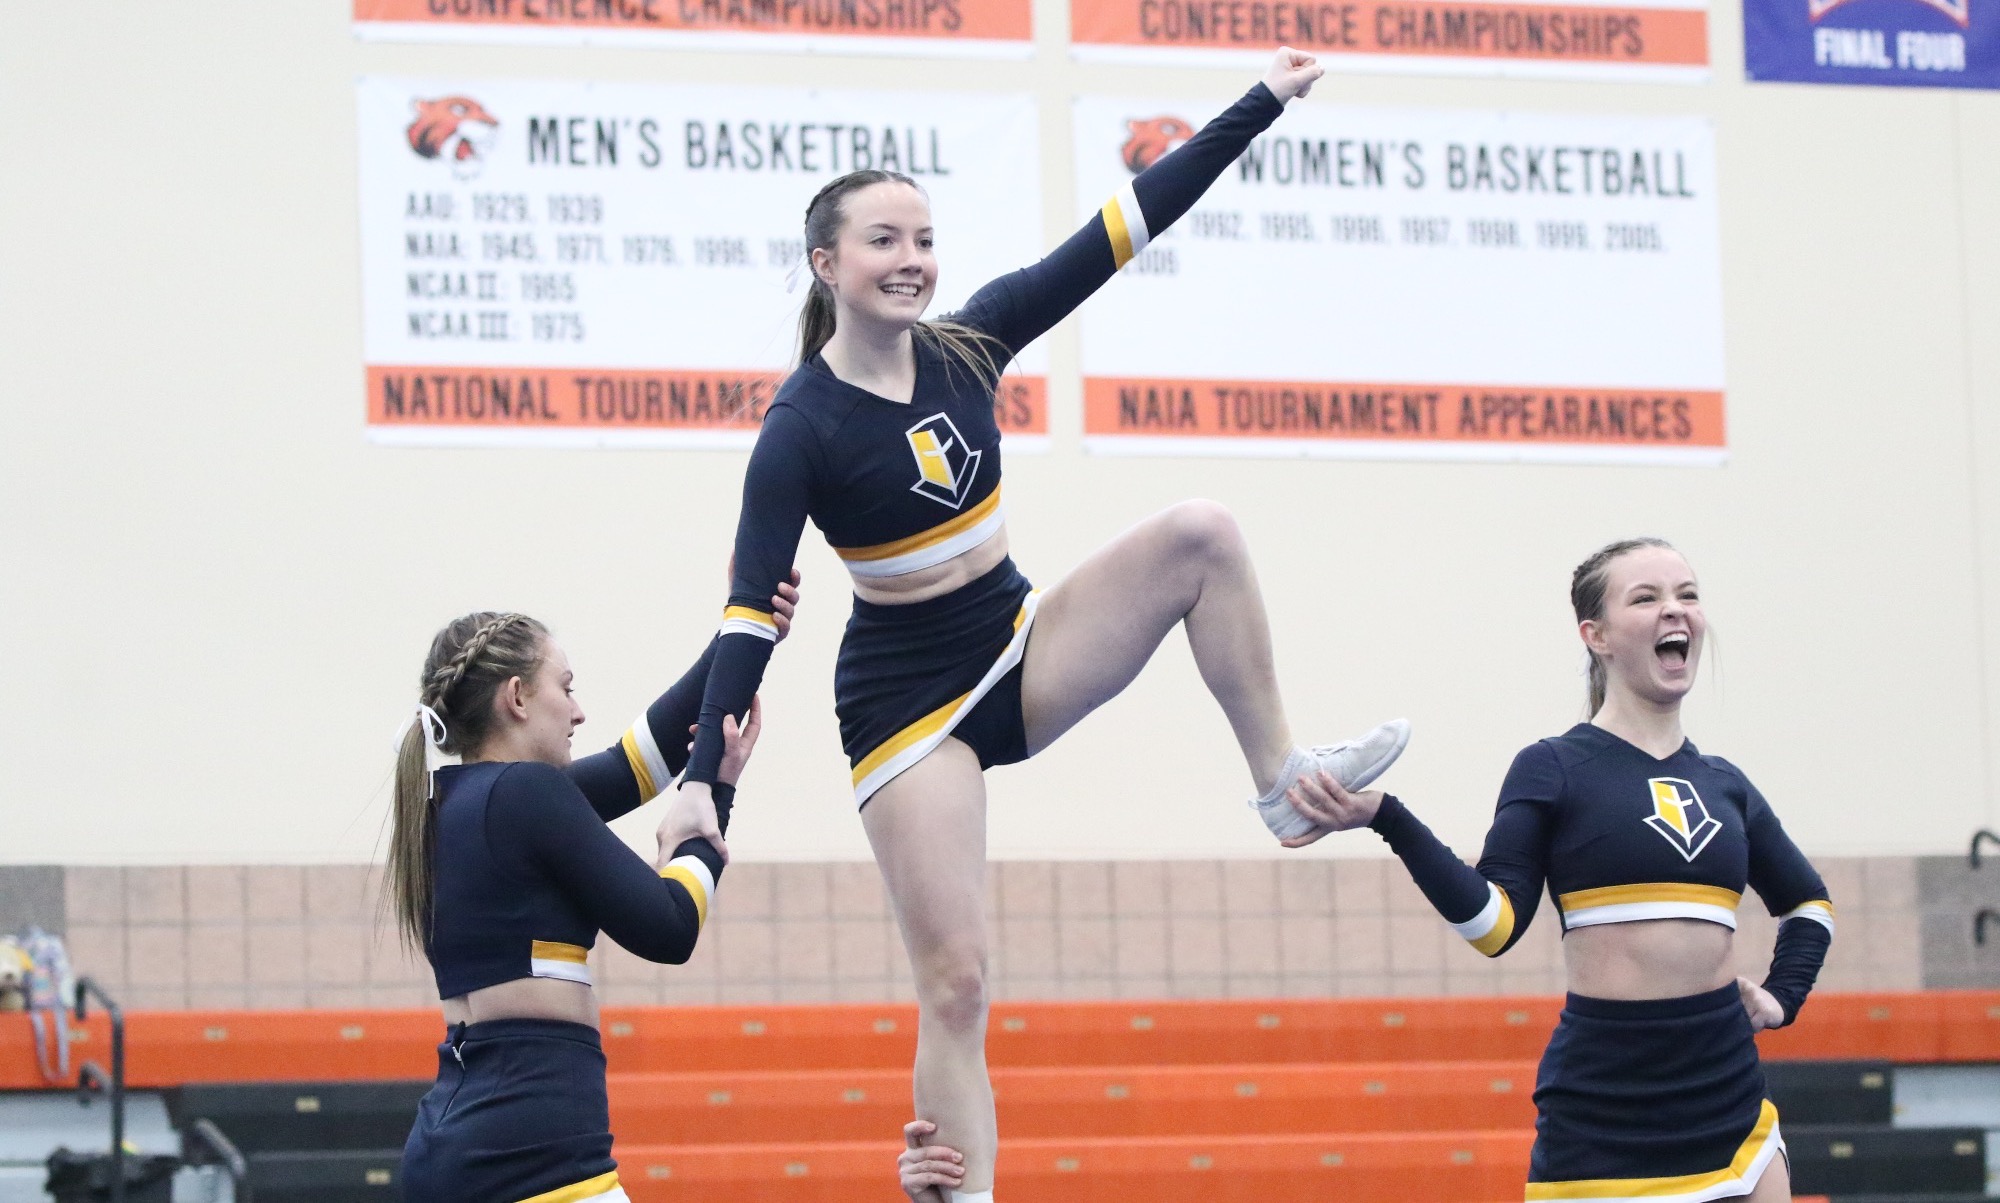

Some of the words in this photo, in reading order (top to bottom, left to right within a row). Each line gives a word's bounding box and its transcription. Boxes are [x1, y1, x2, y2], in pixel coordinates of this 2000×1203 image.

[1139, 0, 1357, 47] CONFERENCE
[1376, 8, 1645, 57] CHAMPIONSHIPS
[1814, 27, 1893, 69] FINAL
[1897, 30, 1967, 72] FOUR
[527, 115, 662, 169] MEN'S
[686, 120, 951, 176] BASKETBALL
[1238, 136, 1426, 188] WOMEN'S
[1446, 142, 1696, 198] BASKETBALL
[548, 193, 604, 225] 1939
[767, 238, 806, 268] 199
[406, 271, 469, 299] NCAA
[408, 311, 472, 339] NCAA
[383, 374, 558, 421] NATIONAL
[571, 377, 779, 423] TOURNAME
[1118, 386, 1197, 428] NAIA
[1212, 388, 1443, 434] TOURNAMENT
[1458, 393, 1693, 441] APPEARANCES
